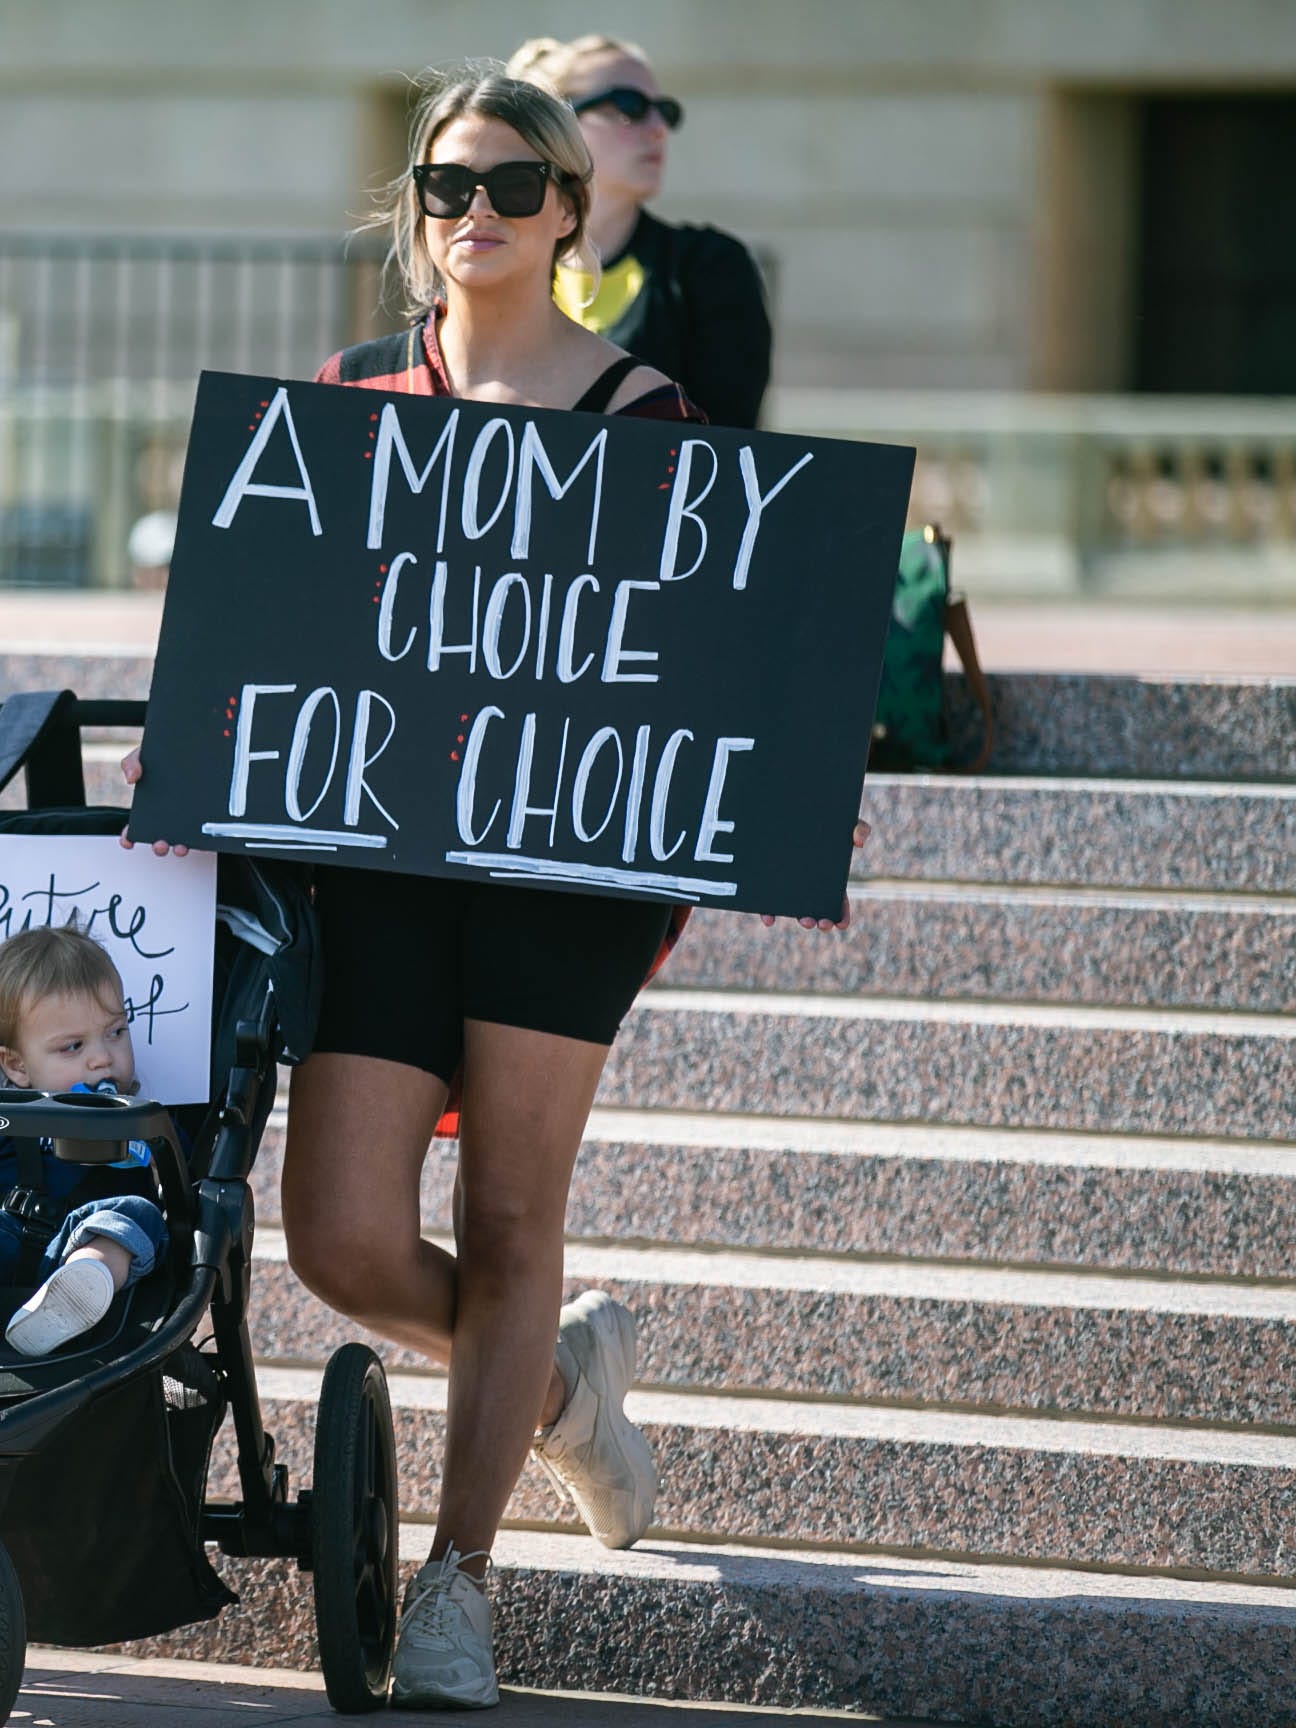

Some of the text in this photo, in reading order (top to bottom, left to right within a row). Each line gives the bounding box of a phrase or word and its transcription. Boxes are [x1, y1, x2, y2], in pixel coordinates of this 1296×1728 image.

[212, 387, 813, 590] A MOM BY
[378, 552, 660, 683] CHOICE
[229, 684, 754, 863] FOR CHOICE
